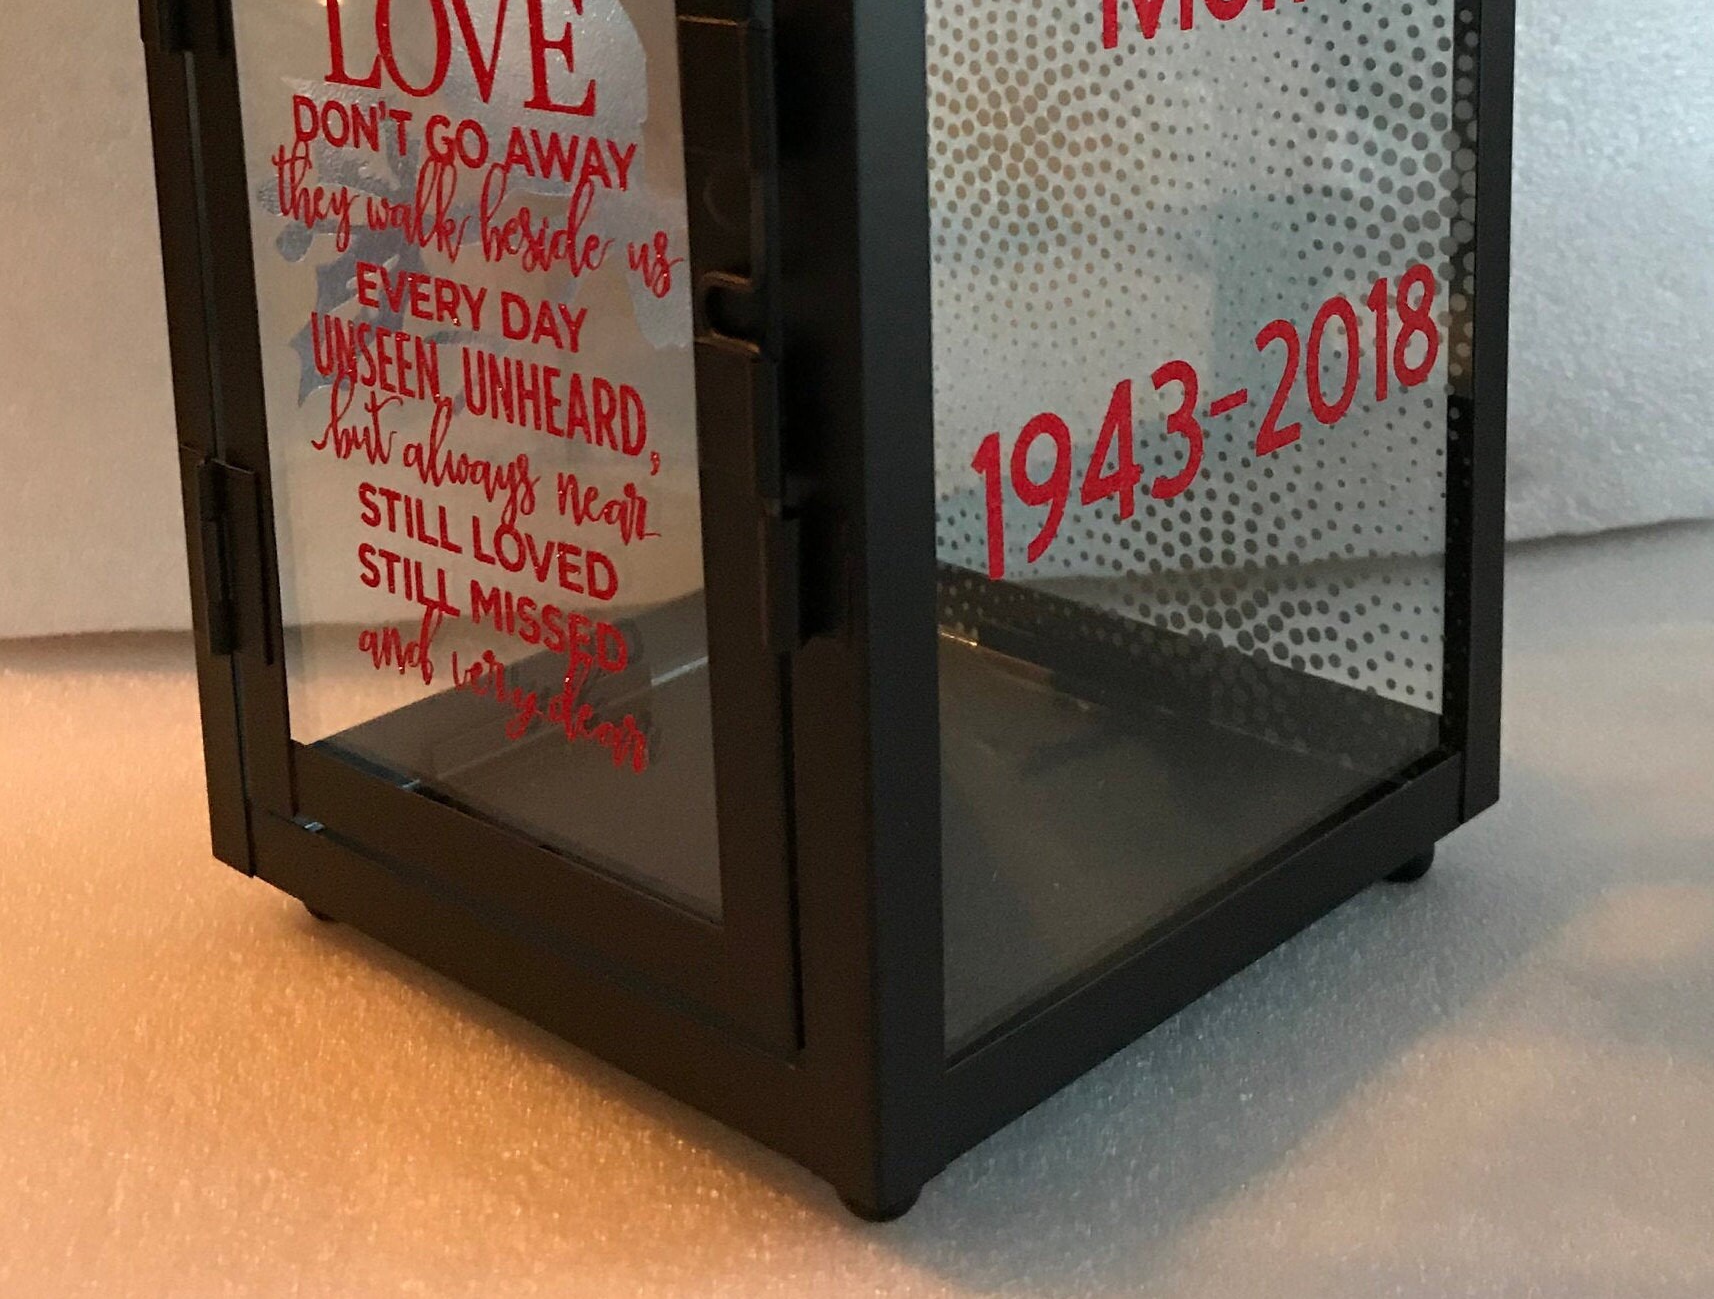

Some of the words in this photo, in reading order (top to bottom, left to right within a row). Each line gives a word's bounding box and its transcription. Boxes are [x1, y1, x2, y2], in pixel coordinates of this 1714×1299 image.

[292, 94, 413, 156] DON'T
[425, 113, 490, 169] GO
[506, 126, 638, 193] AWAY
[271, 140, 357, 253] they
[366, 159, 472, 263] walk
[480, 163, 614, 278] beside
[628, 230, 684, 299] us
[355, 260, 488, 331] EVERY
[500, 290, 588, 354] DAY
[311, 376, 403, 464] but
[402, 396, 541, 526] always
[556, 471, 662, 545] near
[461, 346, 661, 476] UNHEARD,
[970, 263, 1440, 582] 1943-2018
[357, 481, 464, 555] STILL
[472, 515, 619, 601] LOVED
[357, 542, 461, 617] STILL
[469, 578, 629, 674] MISSED
[358, 604, 442, 686] and
[451, 648, 544, 740] very
[546, 648, 650, 775] dear
